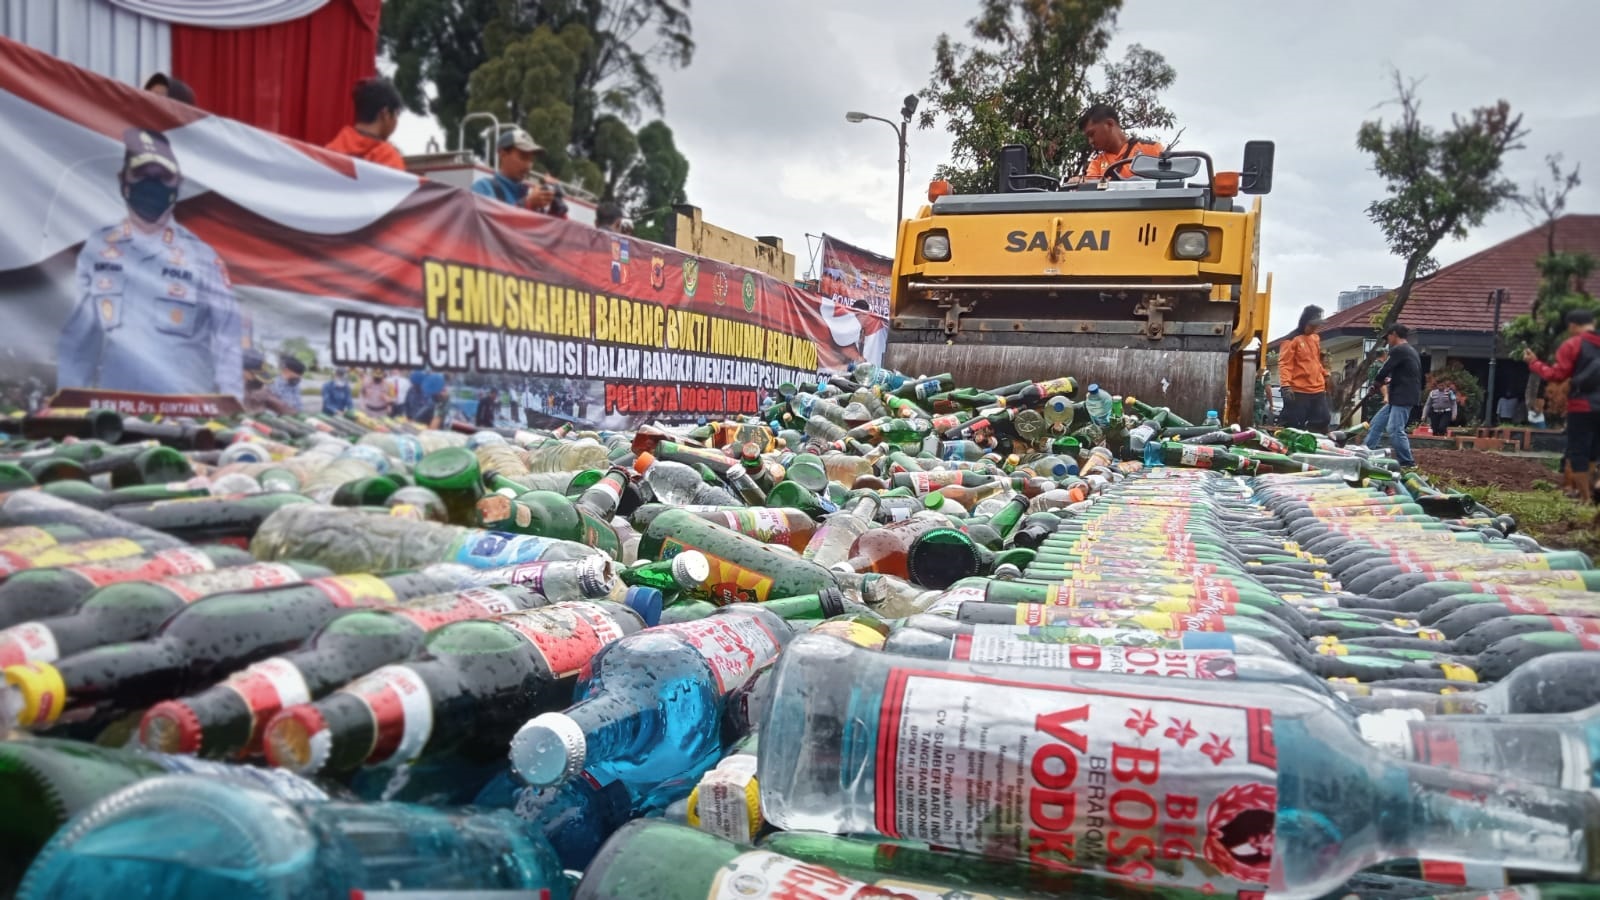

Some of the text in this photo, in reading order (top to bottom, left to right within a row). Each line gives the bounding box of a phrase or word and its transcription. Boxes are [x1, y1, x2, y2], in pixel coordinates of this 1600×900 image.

[1005, 230, 1110, 252] SAKAI
[424, 260, 590, 338] PEMUSNAHAN
[595, 295, 663, 348] BARANG
[334, 315, 424, 364] HASIL
[429, 325, 502, 370] CIPTA
[506, 332, 583, 376] KONDISI
[586, 344, 641, 379] DALAM
[643, 350, 693, 384] RANGKA
[605, 384, 678, 413] POLRESTA
[908, 725, 918, 755] BPOM
[936, 710, 946, 728] CV.
[918, 732, 931, 796] TANGERANG
[931, 732, 944, 783] SUMBER
[906, 776, 915, 791] MD
[930, 787, 941, 818] BARU
[943, 753, 955, 831] Di Produksi Oleh
[1106, 743, 1160, 881] BOSS
[1163, 794, 1198, 861] BIG
